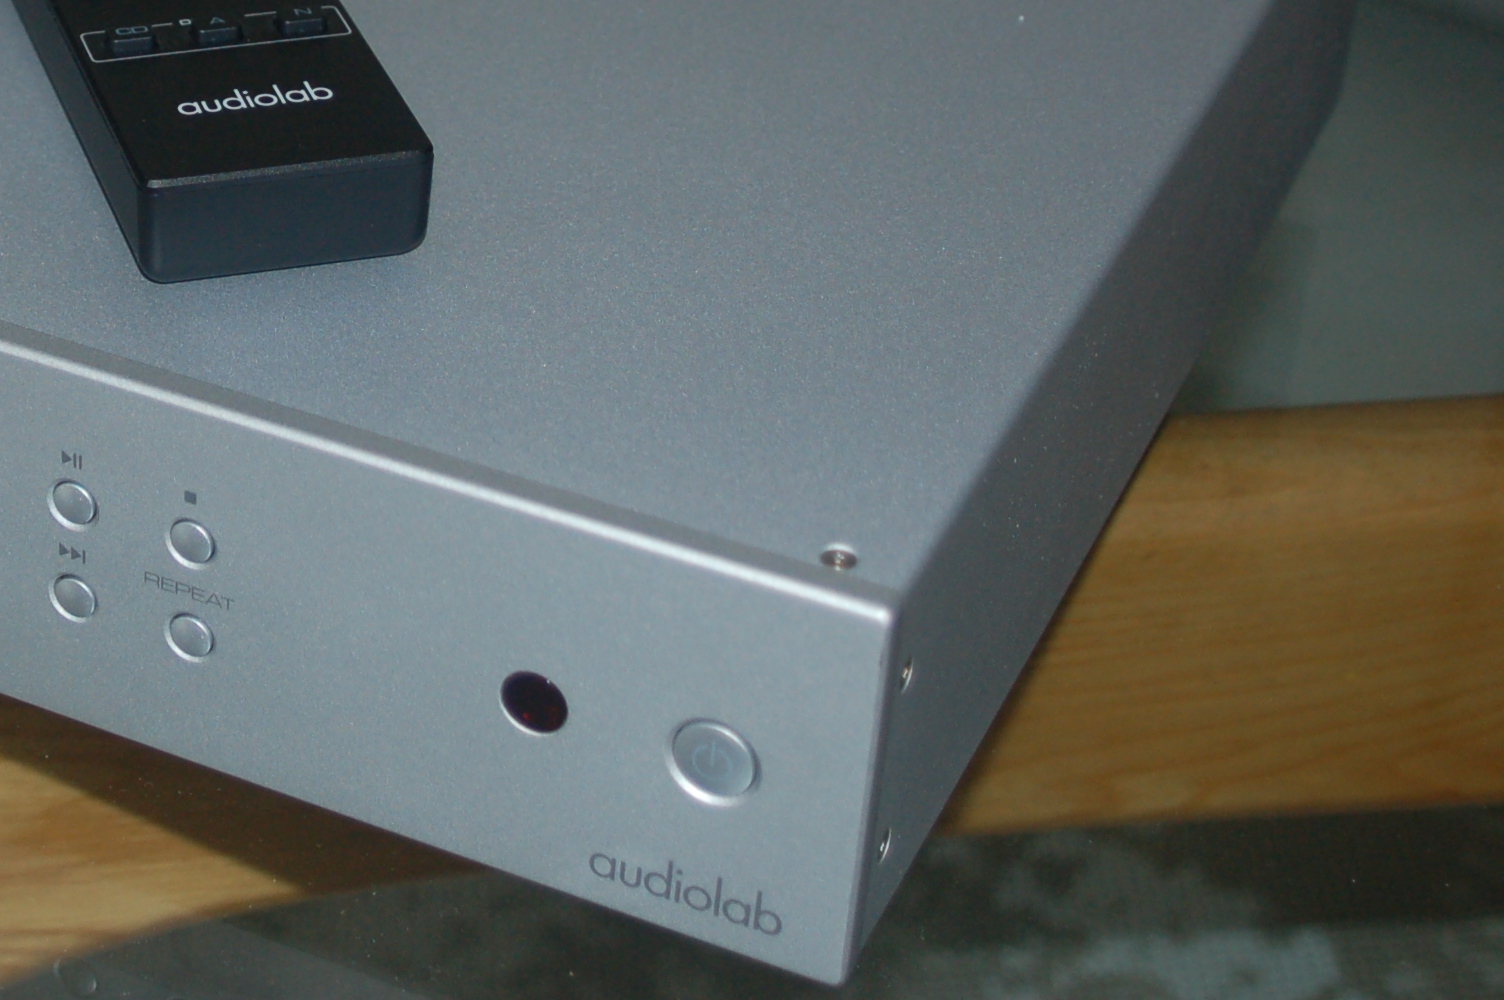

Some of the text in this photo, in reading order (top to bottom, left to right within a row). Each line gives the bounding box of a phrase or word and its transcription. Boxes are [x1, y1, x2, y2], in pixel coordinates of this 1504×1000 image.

[115, 25, 149, 36] CD
[177, 80, 334, 116] audiolab
[143, 570, 236, 611] REPEAT
[588, 851, 783, 937] audiolab
